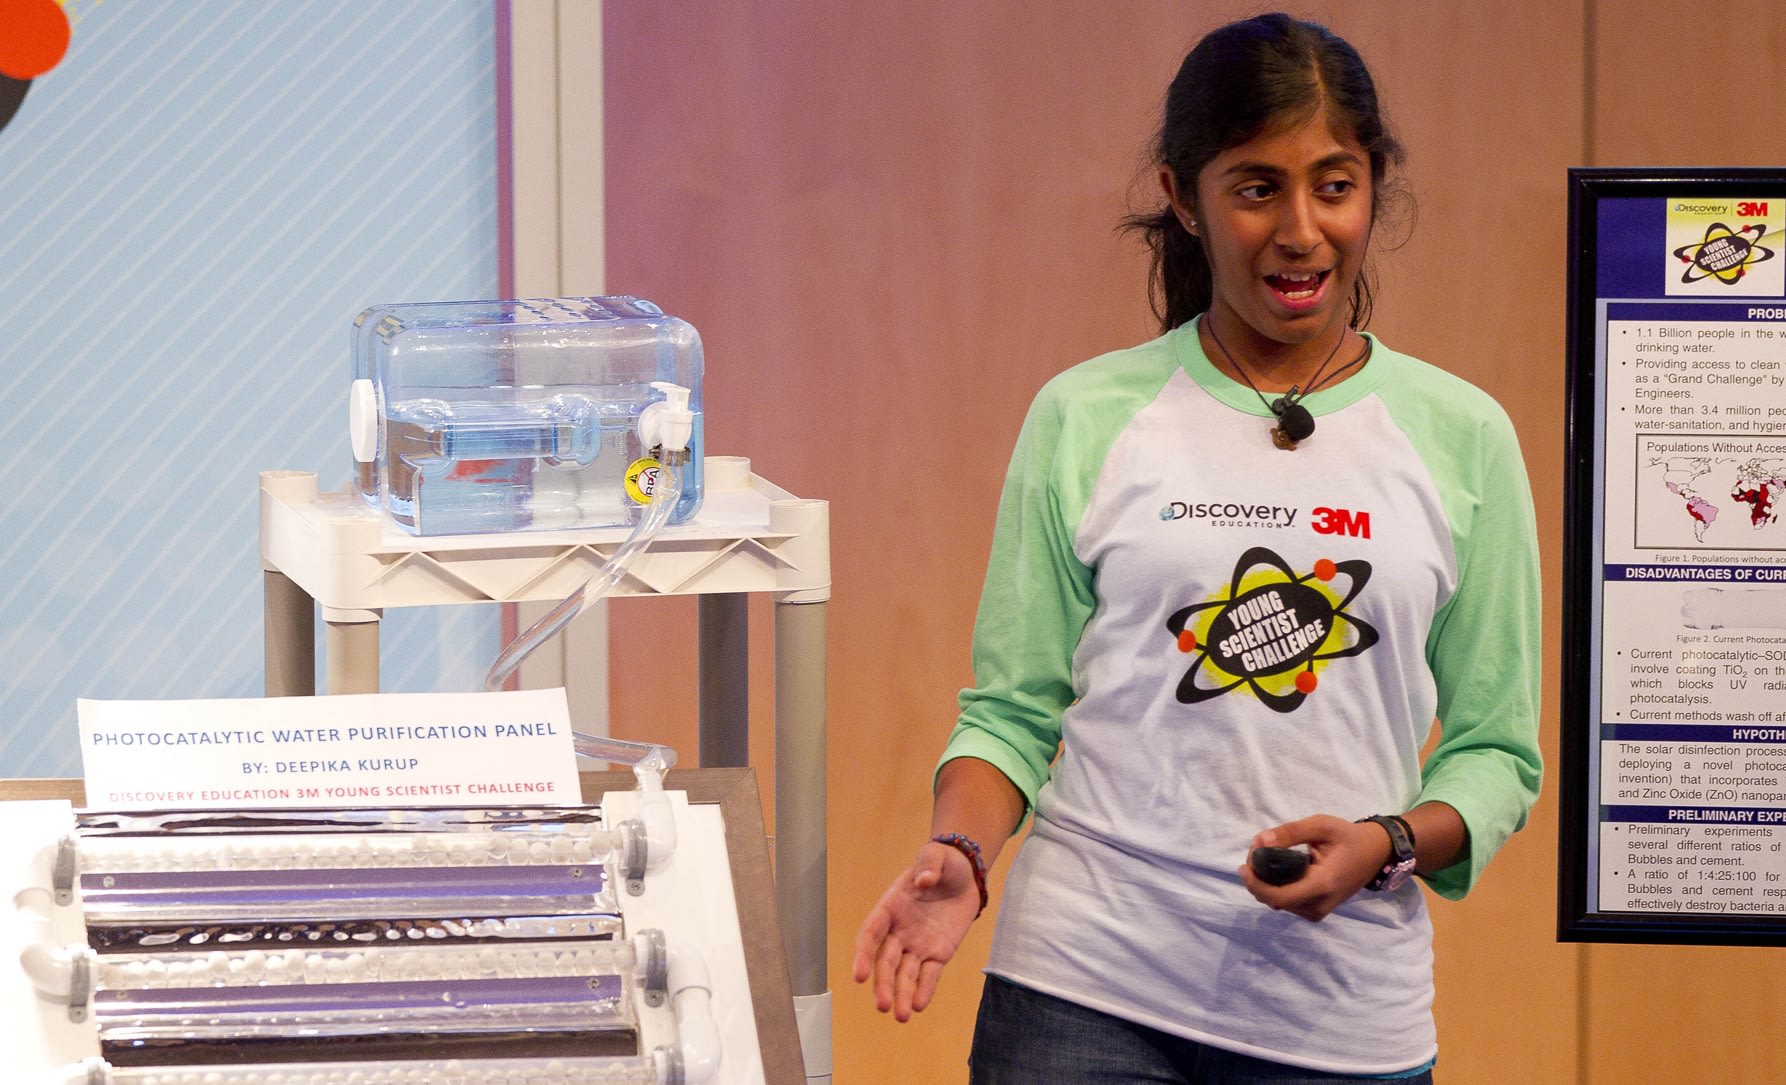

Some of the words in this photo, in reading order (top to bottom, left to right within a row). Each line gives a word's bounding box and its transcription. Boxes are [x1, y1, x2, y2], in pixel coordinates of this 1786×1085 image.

[1678, 204, 1728, 214] Discovery
[1736, 202, 1768, 216] 3M
[1704, 239, 1728, 255] YOUNG
[1700, 245, 1736, 266] SCIENTIST
[1710, 248, 1749, 271] CHALLENGE
[1637, 328, 1652, 337] 1.1
[1660, 328, 1692, 337] Billion
[1698, 328, 1734, 339] people
[1741, 329, 1750, 338] in
[1757, 329, 1773, 338] the
[1636, 344, 1678, 354] drinking
[1683, 344, 1715, 352] water.
[1636, 359, 1687, 371] Providing
[1692, 361, 1730, 369] access
[1736, 360, 1745, 369] to
[1751, 360, 1780, 369] clean
[1772, 375, 1784, 386] by
[1635, 388, 1693, 400] Engineers.
[1635, 405, 1662, 414] More
[1671, 405, 1694, 414] than
[1702, 405, 1718, 414] 3.4
[1726, 406, 1760, 415] million
[1635, 421, 1725, 431] water-sanitation,
[1729, 421, 1749, 430] and
[1648, 442, 1709, 454] Populations
[1712, 443, 1753, 453] Without
[1170, 502, 1297, 526] Discovery
[1311, 507, 1371, 539] 3M
[1212, 521, 1281, 529] EDUCATION
[1656, 555, 1680, 564] Figure
[1692, 555, 1738, 563] Populations
[1626, 568, 1731, 579] DISADVANTAGES
[1735, 569, 1752, 579] OF
[1227, 591, 1284, 630] YOUNG
[1219, 608, 1300, 658] SCIENTIST
[1676, 635, 1701, 643] Figure
[1241, 619, 1326, 672] CHALLENGE
[1631, 649, 1672, 659] Current
[1631, 665, 1669, 674] involve
[1676, 666, 1716, 677] coating
[1754, 667, 1768, 675] on
[1631, 679, 1662, 689] which
[1678, 680, 1713, 689] blocks
[1730, 680, 1747, 689] UV
[1630, 694, 1712, 706] photocatalysis.
[1630, 709, 1671, 720] Current
[1675, 711, 1722, 720] methods
[1726, 712, 1754, 721] wash
[1759, 711, 1771, 721] off
[93, 731, 265, 746] PHOTOCATALYTIC
[272, 728, 340, 743] WATER
[349, 725, 487, 740] PURIFICATION
[495, 723, 557, 737] PANEL
[1619, 744, 1640, 753] The
[1646, 745, 1673, 754] solar
[1678, 745, 1740, 756] disinfection
[242, 763, 268, 774] BY:
[276, 760, 351, 773] DEEPIKA
[358, 759, 419, 771] KURUP
[1619, 759, 1672, 771] deploying
[1684, 761, 1691, 769] a
[1703, 761, 1733, 770] novel
[1619, 774, 1672, 786] invention)
[1681, 775, 1701, 784] that
[1709, 776, 1777, 787] incorporates
[110, 791, 194, 802] DISCOVERY
[202, 789, 289, 800] EDUCATION
[297, 788, 319, 798] 3M
[325, 787, 380, 798] YOUNG
[386, 785, 461, 796] SCIENTIST
[468, 782, 555, 793] CHALLENGE
[1619, 789, 1639, 798] and
[1643, 788, 1666, 799] Zinc
[1670, 789, 1701, 799] Oxide
[1705, 790, 1737, 801] (ZnO)
[1669, 810, 1754, 821] PRELIMINARY
[1629, 825, 1690, 837] Preliminary
[1705, 827, 1772, 839] experiments
[1628, 840, 1668, 849] several
[1677, 841, 1721, 851] different
[1731, 842, 1761, 851] ratios
[1771, 842, 1781, 851] of
[1628, 854, 1672, 865] Bubbles
[1676, 855, 1696, 865] and
[1701, 857, 1744, 866] cement.
[1628, 869, 1636, 878] A
[1645, 870, 1668, 879] ratio
[1678, 870, 1688, 879] of
[1699, 871, 1756, 881] 1:4:25:100
[1766, 872, 1780, 881] for
[1628, 884, 1672, 894] Bubbles
[1682, 885, 1702, 894] and
[1712, 887, 1753, 896] cement
[1628, 899, 1682, 910] effectively
[1686, 901, 1728, 912] destroy
[1730, 901, 1774, 911] bacteria
